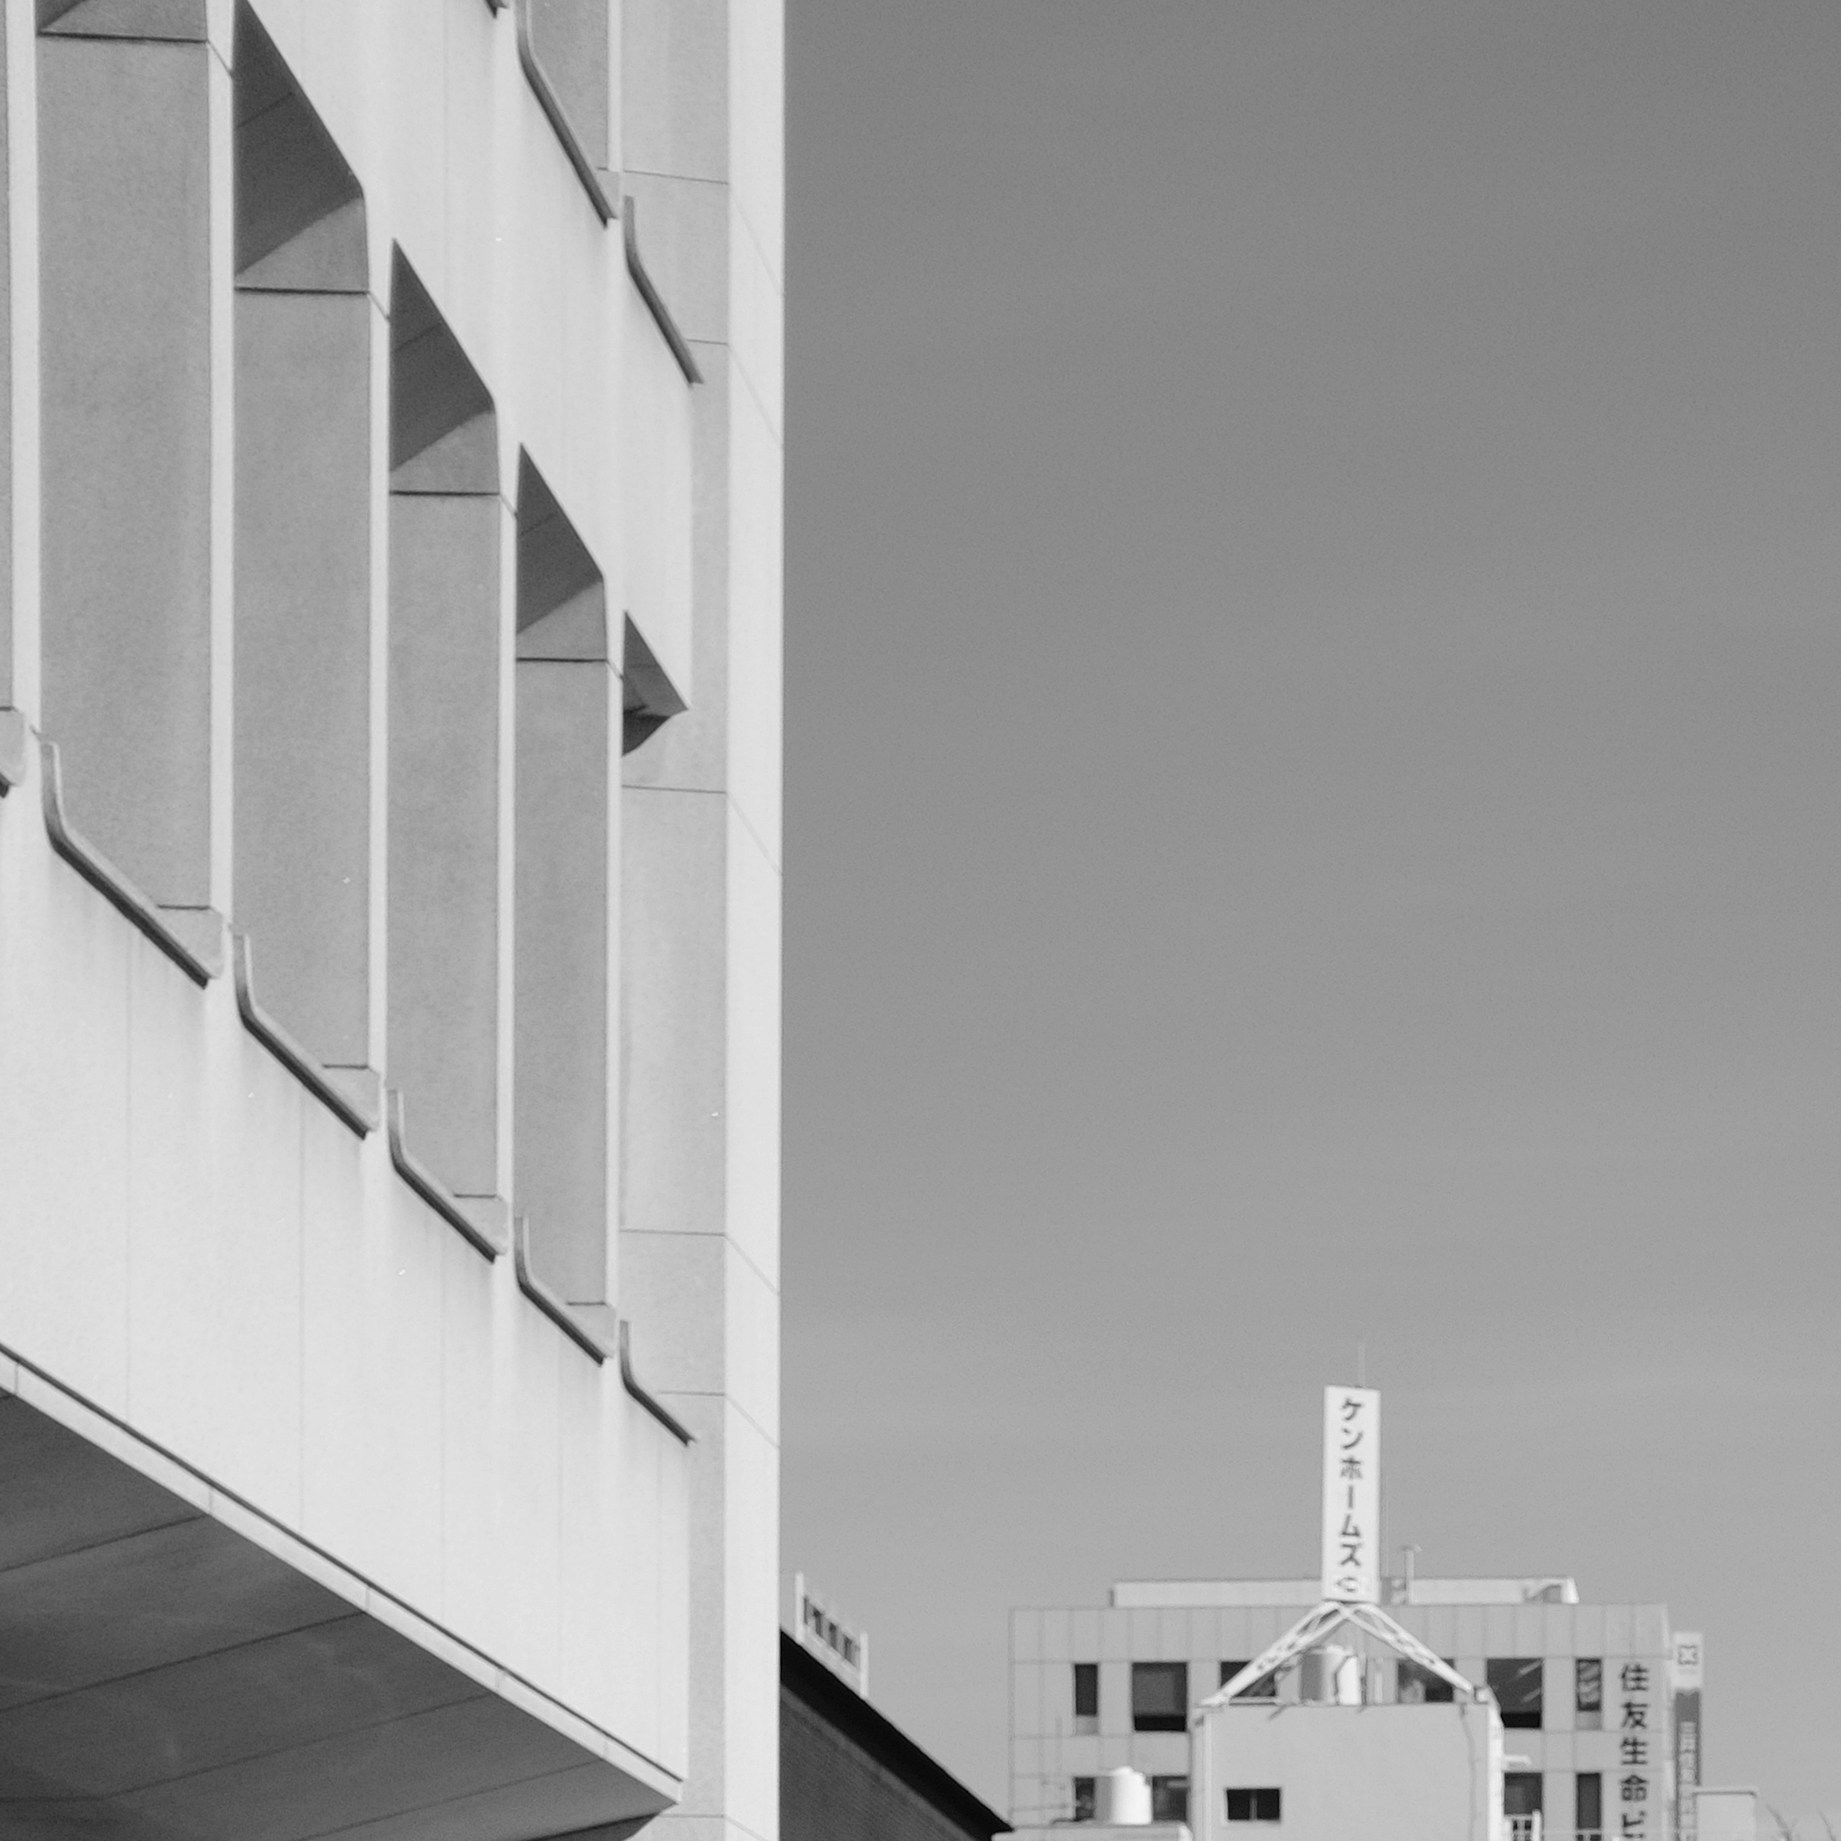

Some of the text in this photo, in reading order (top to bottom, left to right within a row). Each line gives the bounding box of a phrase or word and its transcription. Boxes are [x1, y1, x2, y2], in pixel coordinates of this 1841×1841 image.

[1340, 1397, 1364, 1567] ケンホームズ
